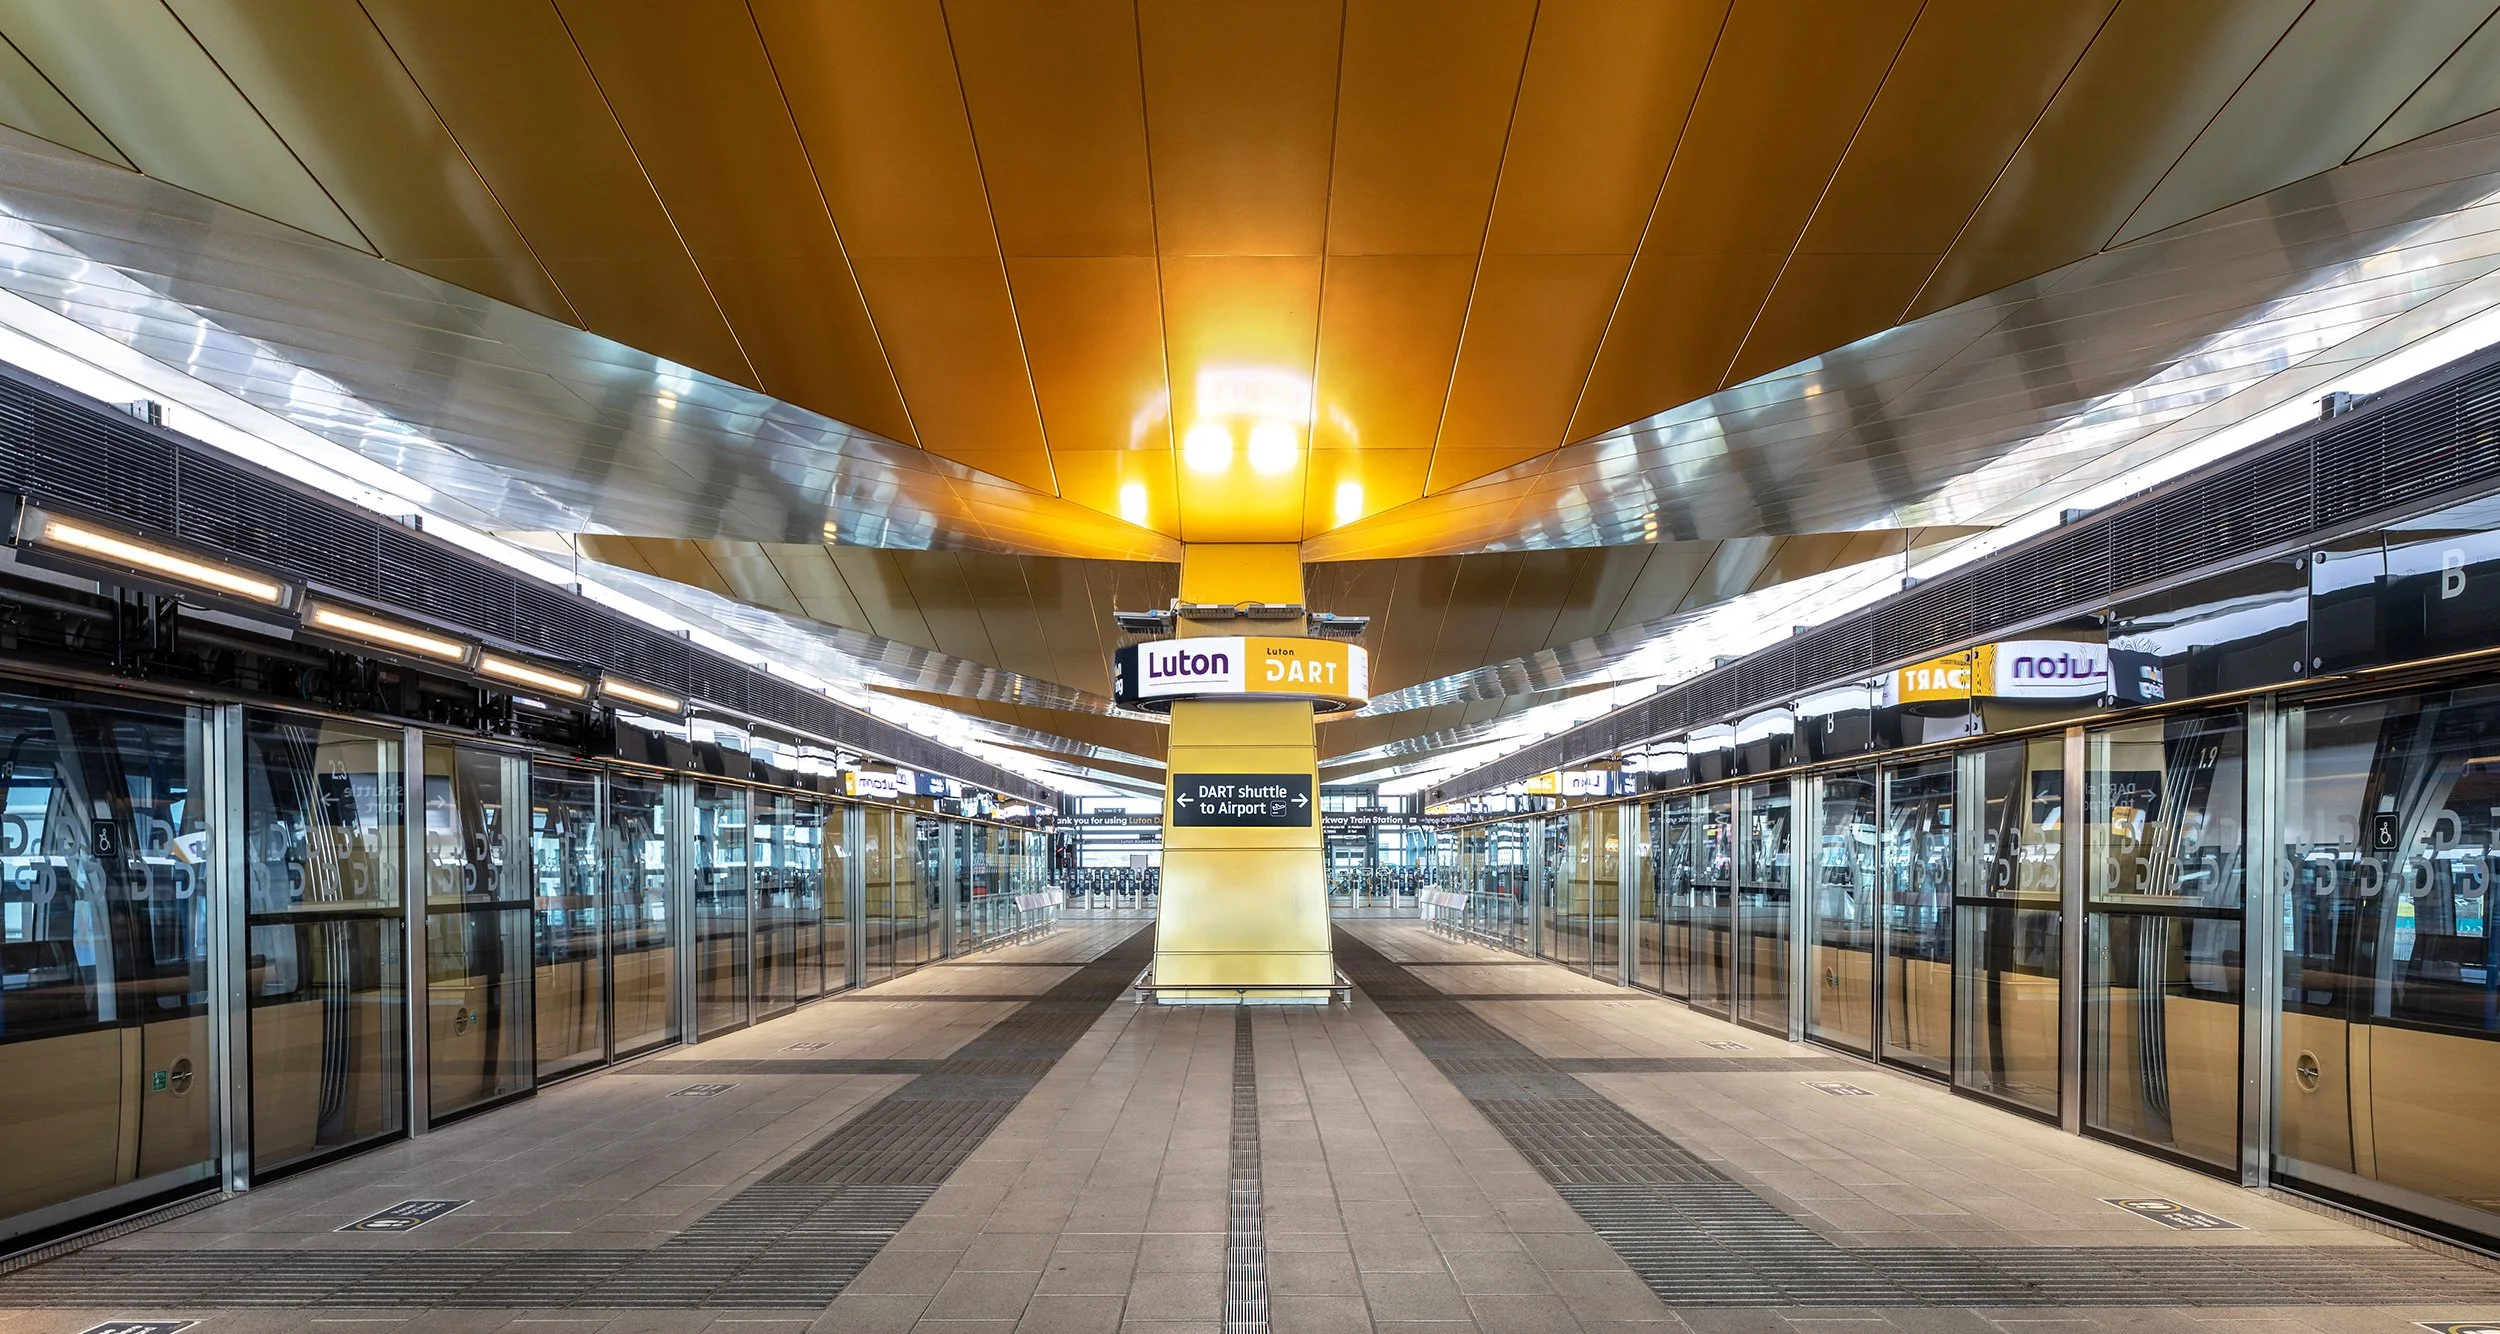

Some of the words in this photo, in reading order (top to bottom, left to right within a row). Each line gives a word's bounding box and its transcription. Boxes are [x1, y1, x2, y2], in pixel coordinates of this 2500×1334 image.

[2441, 548, 2466, 600] B
[1266, 647, 1295, 656] Luton
[1149, 650, 1229, 678] Luton
[1265, 659, 1337, 685] DART
[1827, 712, 1835, 734] B
[2198, 746, 2219, 769] 1.9
[328, 760, 348, 781] 2.3
[1198, 785, 1235, 798] DART
[1238, 784, 1288, 798] shuttle
[1199, 802, 1215, 814] to
[1217, 801, 1267, 817] Airport
[1350, 815, 1371, 824] Train
[1372, 815, 1403, 824] Station
[1073, 818, 1089, 826] you
[1090, 816, 1102, 824] for
[1104, 817, 1127, 826] using
[1129, 816, 1152, 824] Luton
